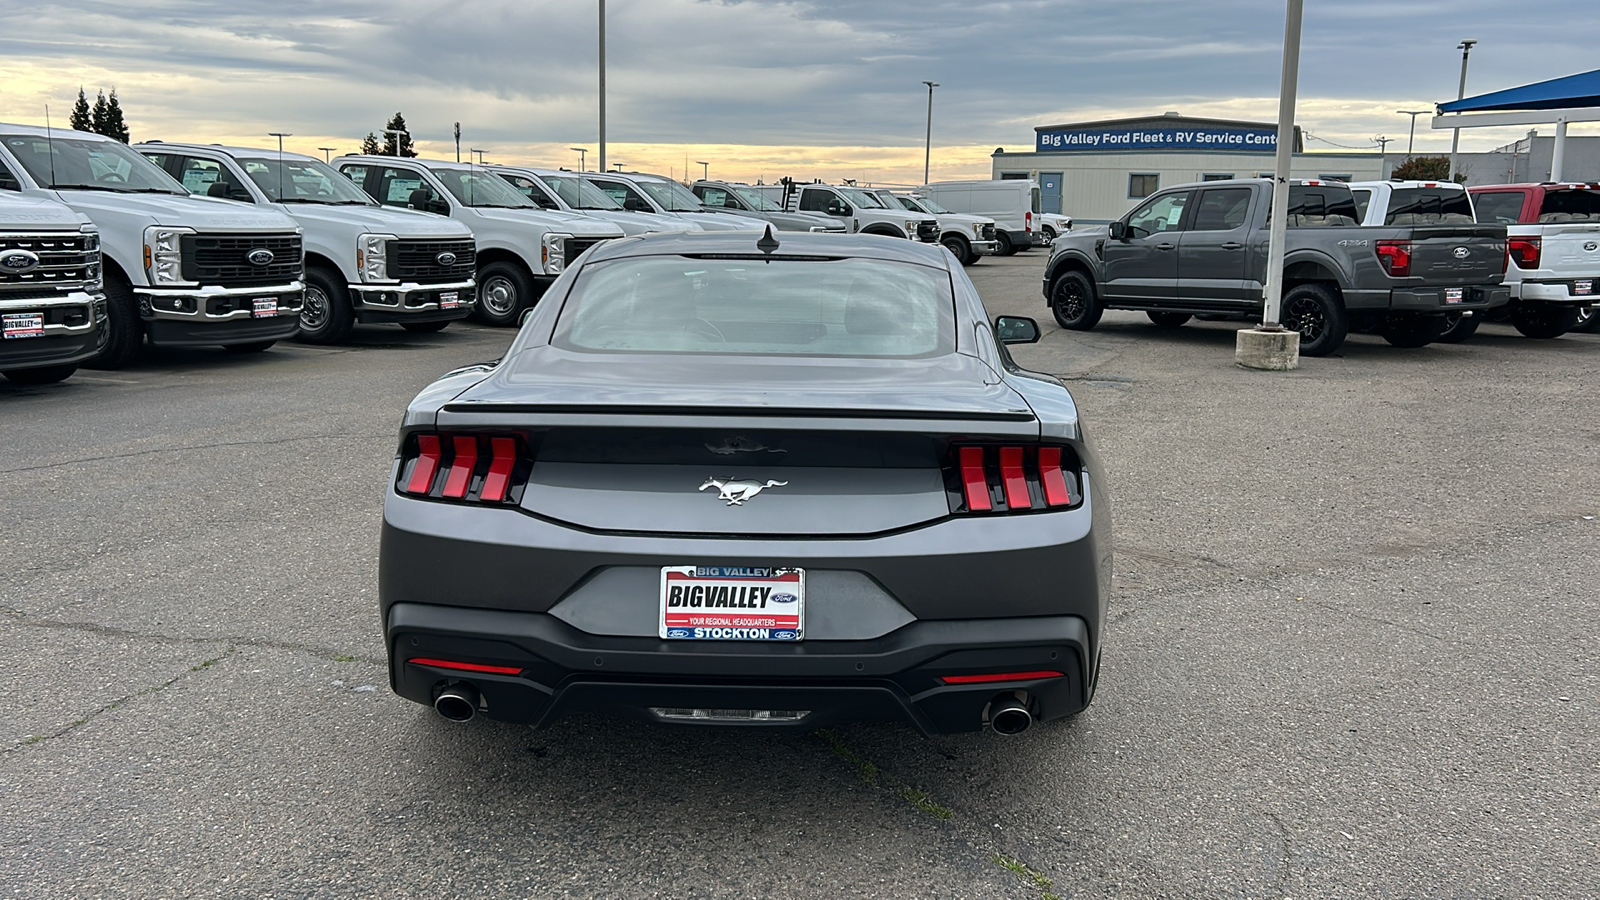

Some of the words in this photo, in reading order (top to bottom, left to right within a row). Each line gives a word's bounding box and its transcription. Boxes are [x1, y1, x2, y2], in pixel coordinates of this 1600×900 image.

[1041, 135, 1061, 147] Big
[1063, 134, 1100, 146] Valley
[1102, 132, 1130, 144] Ford
[1132, 132, 1164, 143] Fleet
[1166, 134, 1173, 142] &
[1175, 132, 1194, 143] RV
[1196, 132, 1243, 144] Service
[1245, 133, 1279, 145] Cent
[7, 255, 30, 267] Ford
[697, 567, 719, 576] BIG
[723, 567, 770, 577] VALLEY
[668, 585, 772, 608] BIGVALLEY
[689, 617, 705, 625] YOUR
[705, 617, 732, 626] REGIONAL
[732, 618, 775, 627] HEADQUARTERS
[694, 628, 770, 639] STOCKTON
